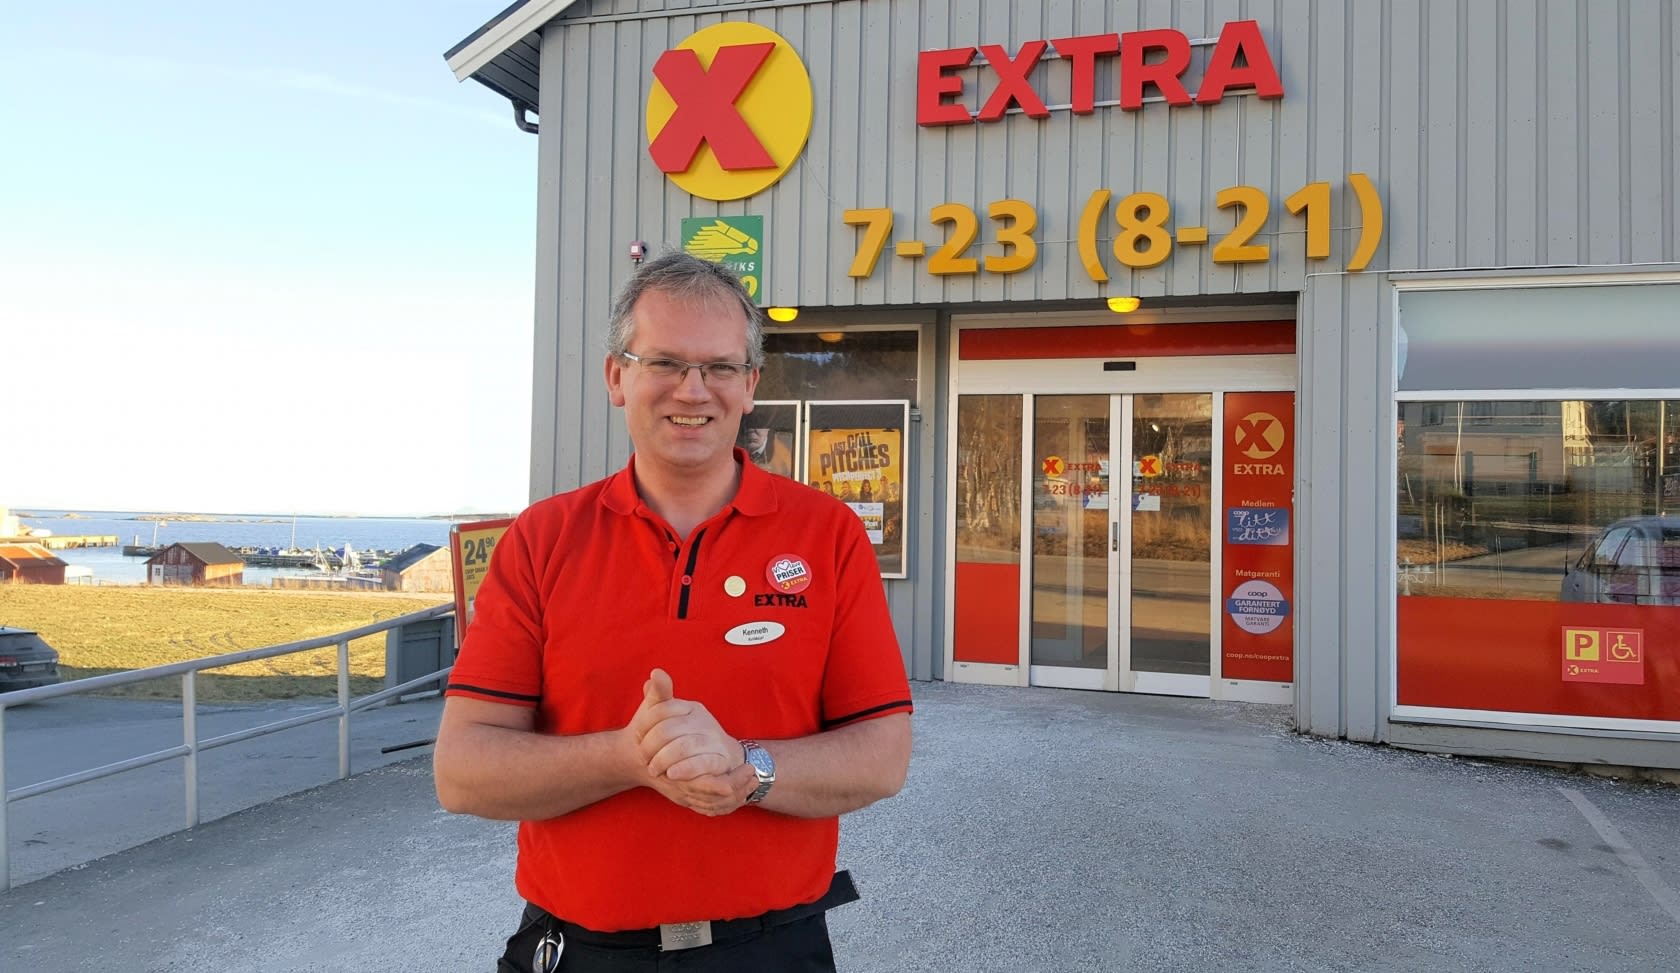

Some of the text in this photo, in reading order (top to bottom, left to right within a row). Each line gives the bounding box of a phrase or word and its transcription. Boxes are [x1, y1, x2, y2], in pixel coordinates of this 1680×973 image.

[917, 20, 1284, 127] EXTRA
[843, 173, 1384, 282] 7-23 (8-21)
[820, 443, 891, 477] PITCHES
[1067, 463, 1103, 473] EXTRA
[1233, 463, 1285, 476] EXTRA
[1241, 499, 1276, 508] Medlem
[776, 567, 804, 580] PRISER
[1235, 569, 1282, 579] Matgaranti
[754, 594, 809, 609] EXTRA
[1234, 599, 1281, 608] GARANTERT
[1238, 606, 1276, 614] FORNØYD
[742, 626, 769, 636] Kenneth
[1574, 633, 1594, 657] P
